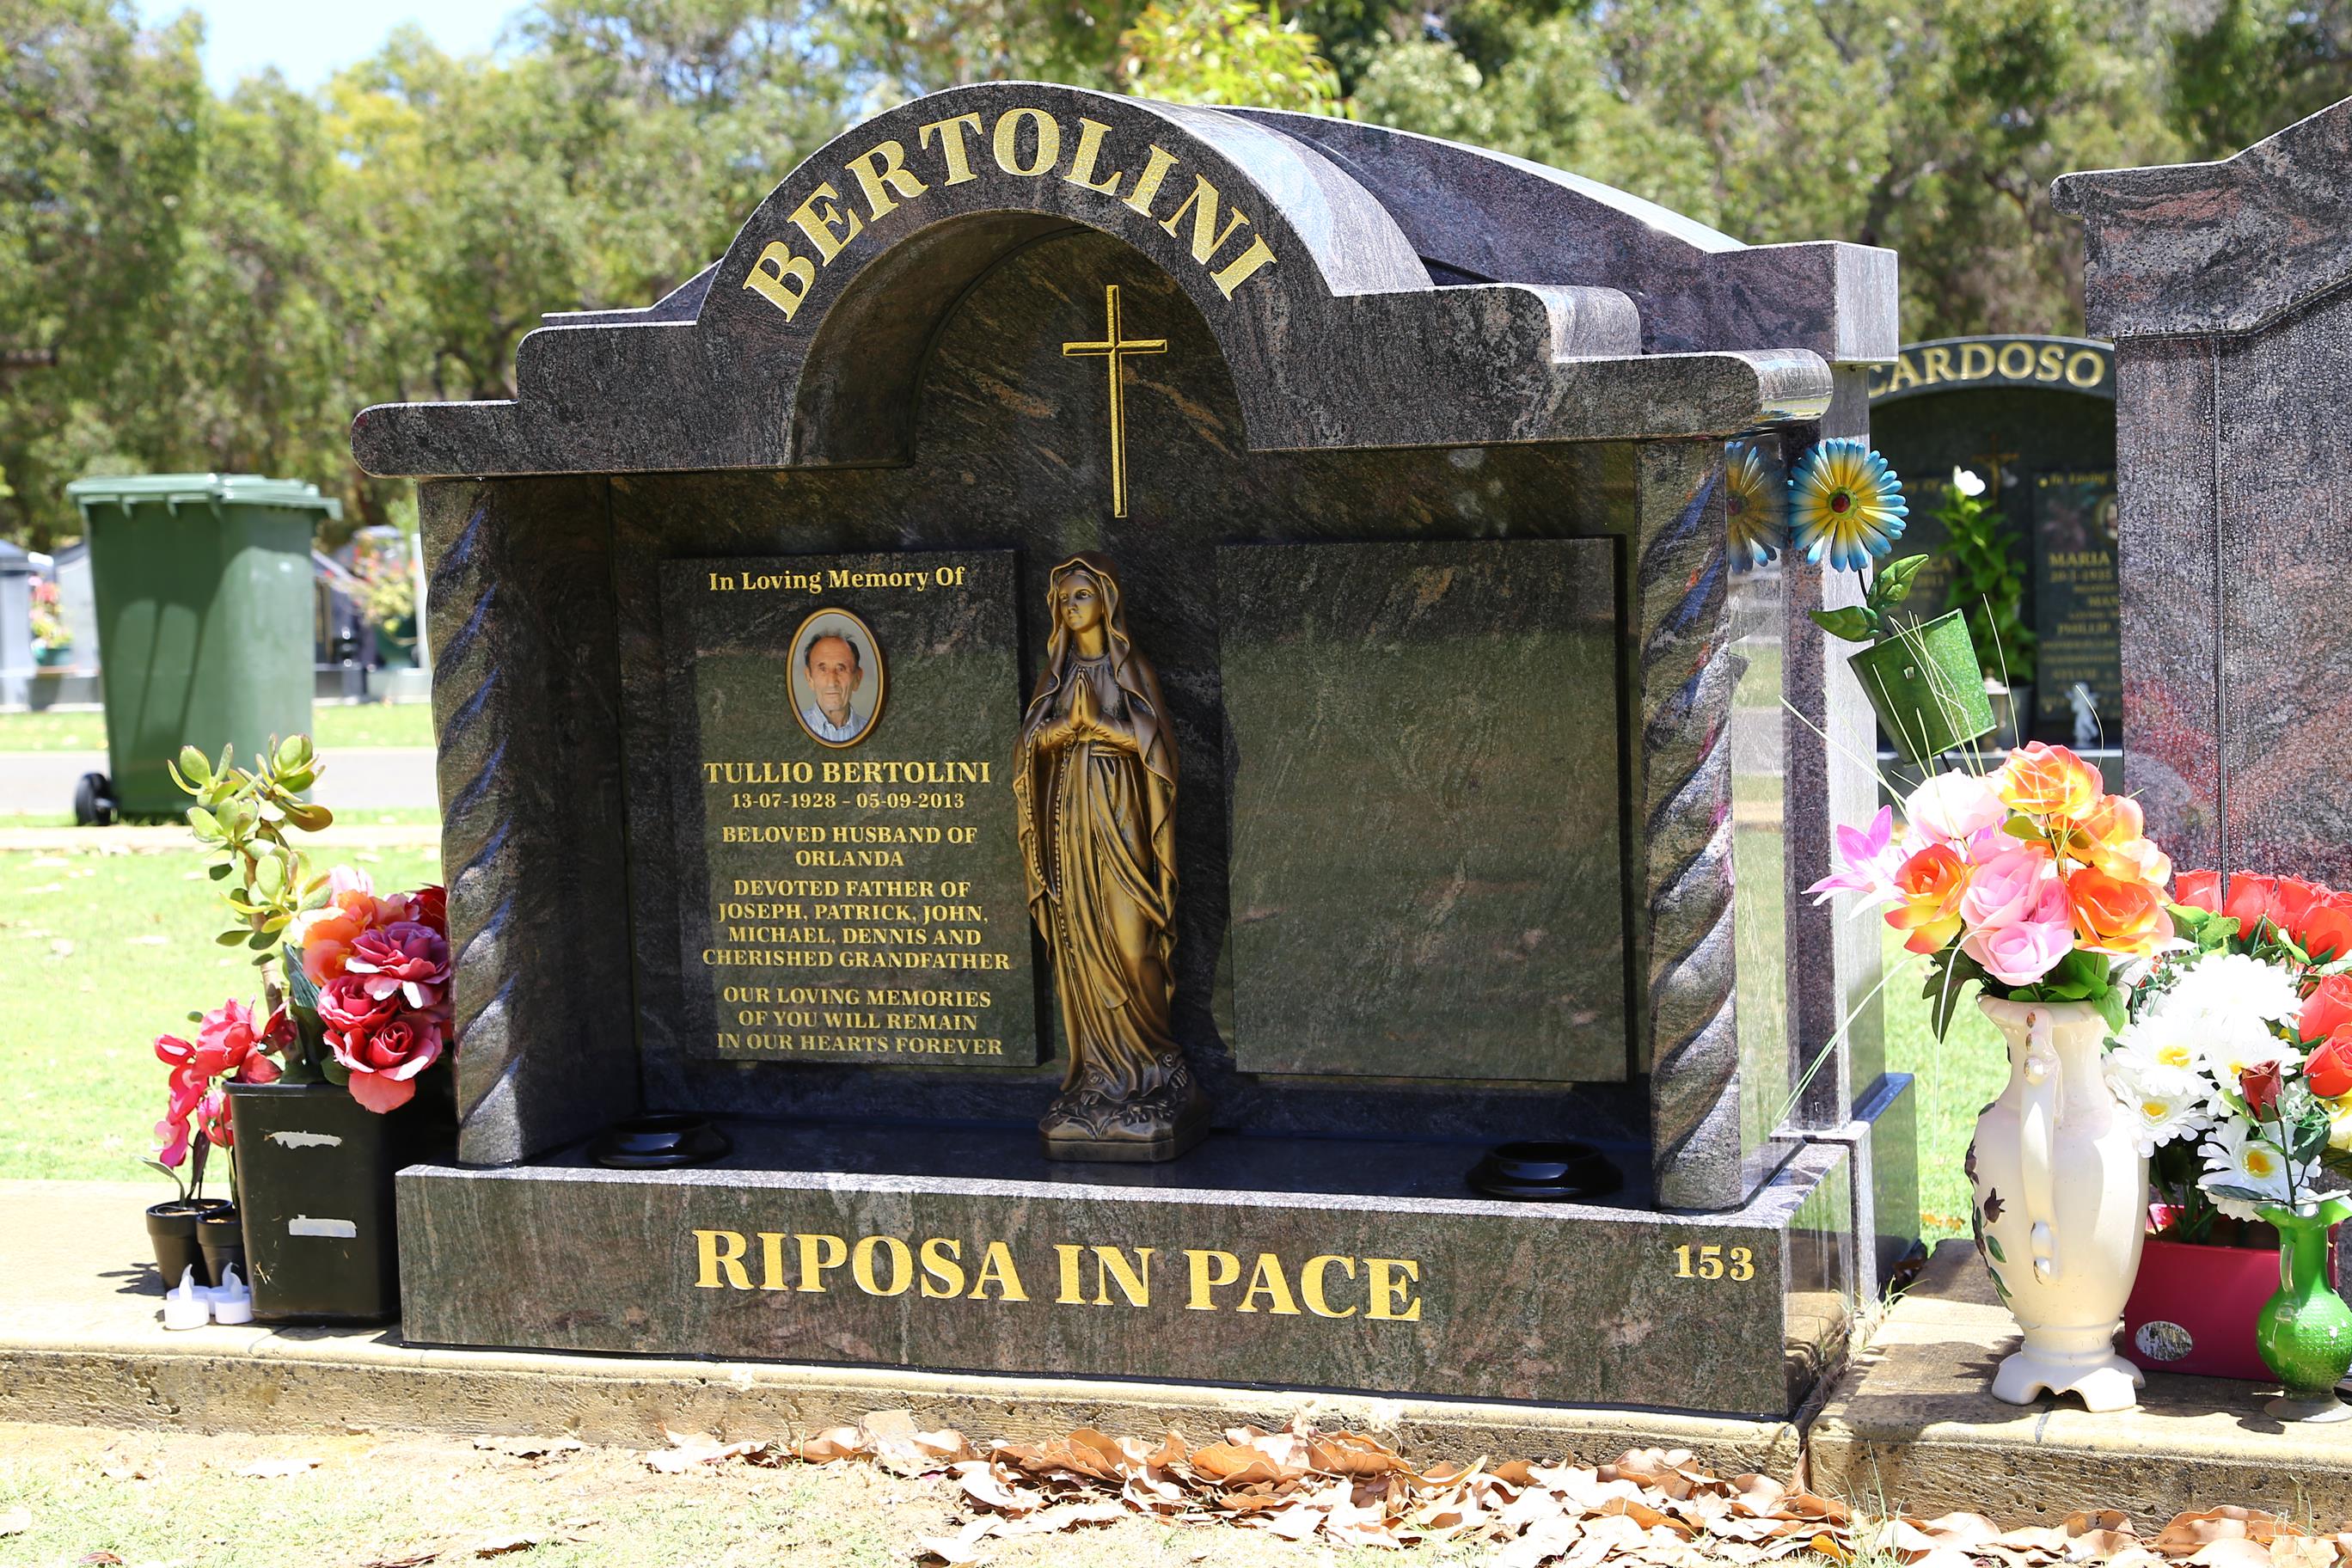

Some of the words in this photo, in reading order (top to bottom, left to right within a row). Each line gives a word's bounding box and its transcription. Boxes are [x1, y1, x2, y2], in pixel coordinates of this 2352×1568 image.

[742, 107, 1278, 323] BERTOLINI
[1868, 342, 2105, 399] CARDOSO
[2049, 551, 2110, 567] MARIA
[710, 573, 733, 590] In
[743, 571, 822, 594] Loving
[829, 570, 928, 591] Memory
[936, 567, 965, 585] Of
[704, 763, 812, 783] TULLIO
[822, 762, 990, 783] BERTOLINI
[732, 793, 836, 808] 13-07-1928
[856, 792, 965, 810] 05-09-2013
[723, 826, 826, 842] BELOVED
[832, 827, 940, 843] HUSBAND
[947, 827, 977, 843] OF
[795, 850, 904, 867] ORLANDA
[734, 880, 840, 897] DEVOTED
[846, 880, 935, 897] FATHER
[940, 881, 970, 897] OF
[720, 903, 808, 922] JOSEPH,
[814, 904, 916, 923] PATRICK,
[922, 904, 988, 925] JOHN,
[729, 927, 835, 943] MICHAEL,
[842, 928, 927, 944] DENNIS
[934, 929, 981, 945] AND
[703, 949, 834, 966] CHERISHED
[840, 952, 1012, 970] GRANDFATHER
[724, 987, 769, 1002] OUR
[777, 988, 860, 1005] LOVING
[867, 989, 990, 1007] MEMORIES
[738, 1011, 765, 1025] OF
[775, 1011, 818, 1027] YOU
[825, 1013, 880, 1028] WILL
[887, 1014, 976, 1029] REMAIN
[717, 1032, 740, 1049] IN
[747, 1035, 792, 1050] OUR
[801, 1035, 888, 1052] HEARTS
[897, 1038, 1002, 1054] FOREVER
[1673, 1244, 1755, 1280] 153
[692, 1228, 1032, 1302] RIPOSA
[1053, 1244, 1156, 1307] IN
[1183, 1249, 1422, 1320] PACE
